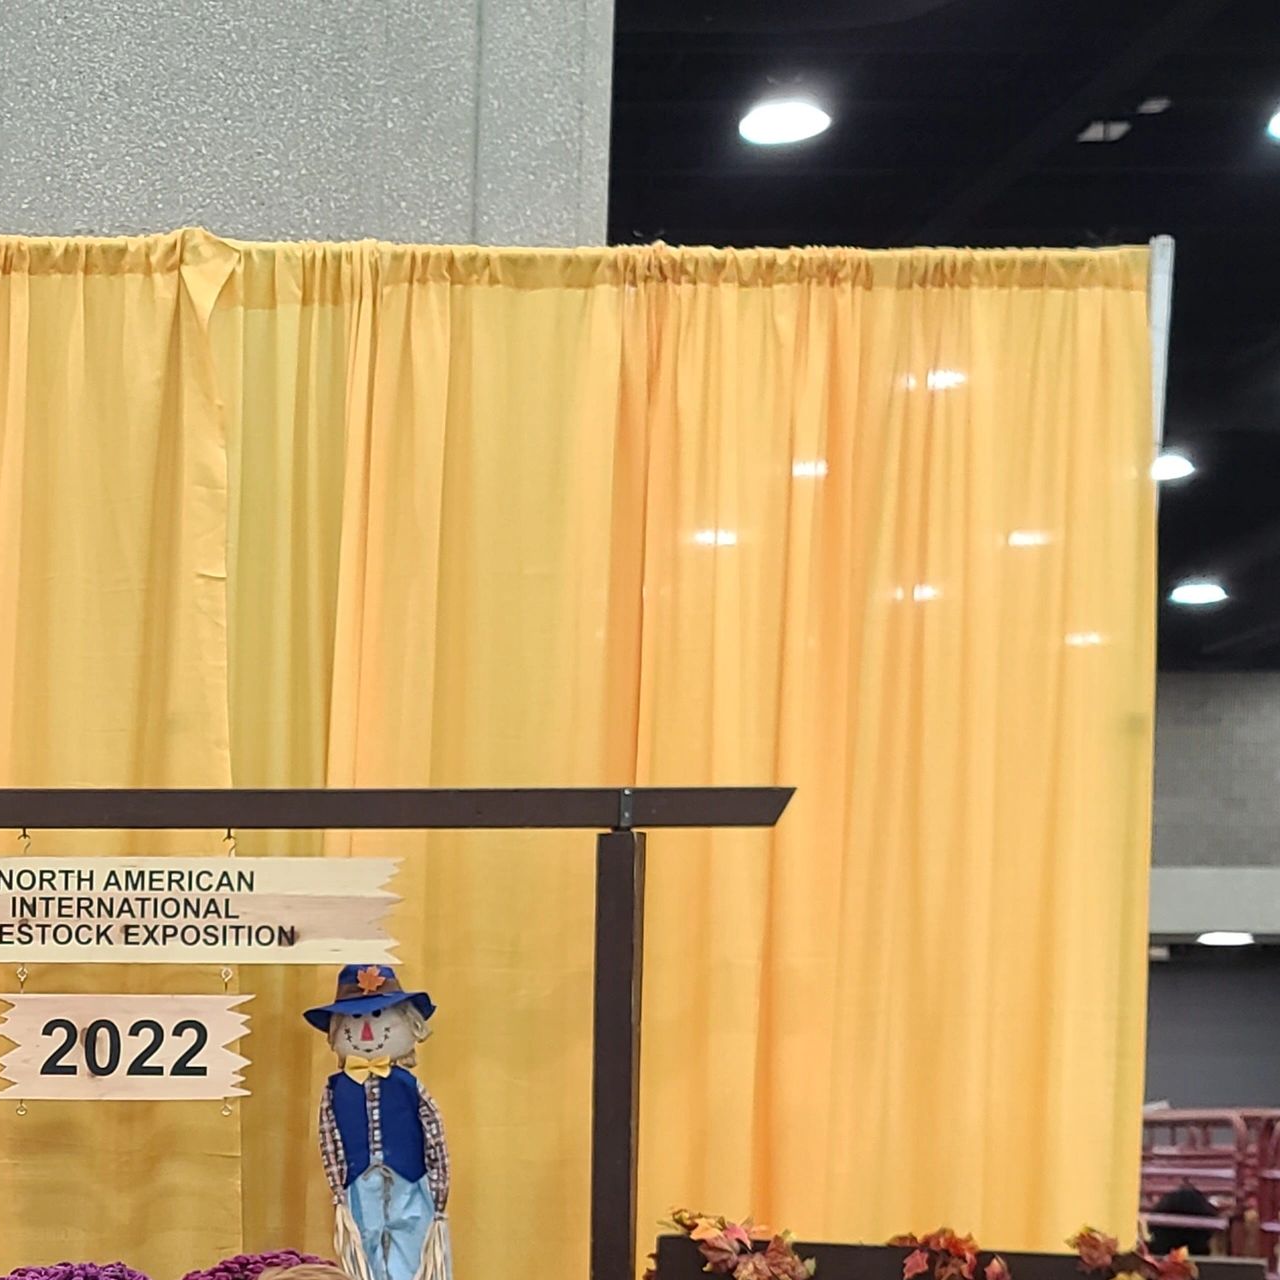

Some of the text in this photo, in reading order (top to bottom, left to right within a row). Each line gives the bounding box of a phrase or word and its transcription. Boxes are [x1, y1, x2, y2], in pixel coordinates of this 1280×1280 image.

[103, 869, 255, 892] AMERICAN
[11, 896, 240, 919] INTERNATIONAL
[123, 924, 296, 947] EXPOSITION
[39, 1018, 209, 1078] 2022
